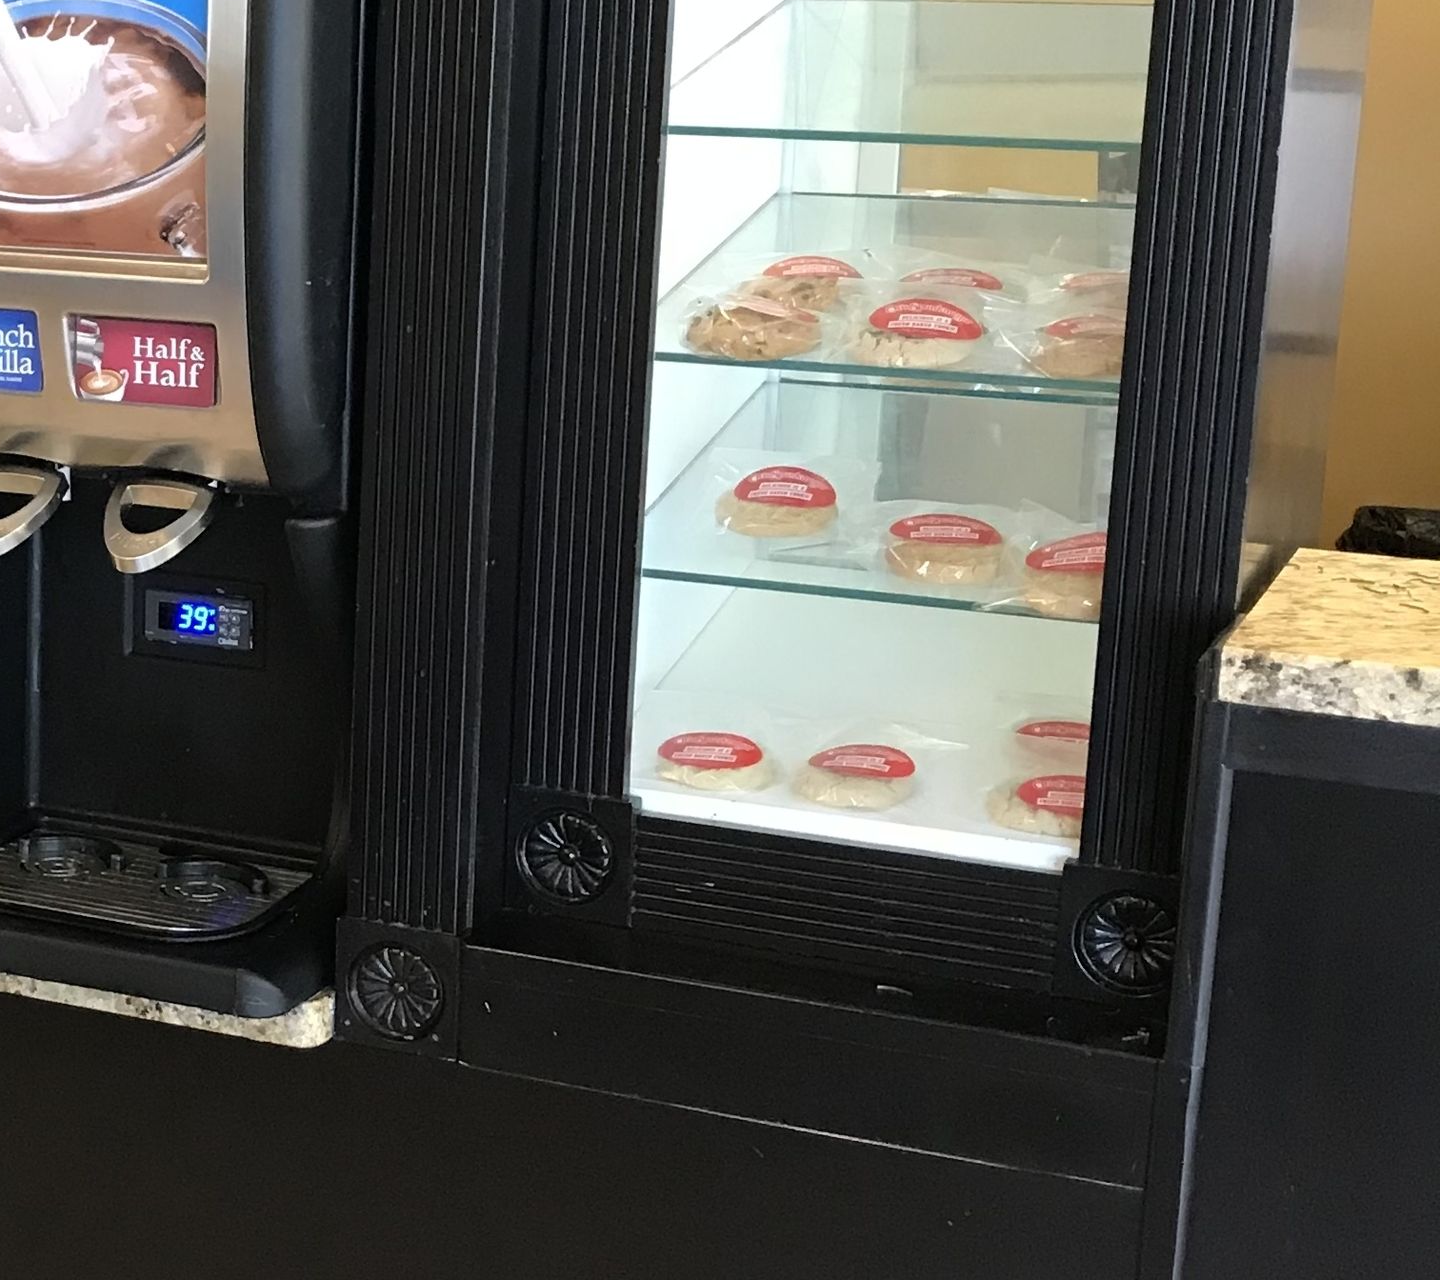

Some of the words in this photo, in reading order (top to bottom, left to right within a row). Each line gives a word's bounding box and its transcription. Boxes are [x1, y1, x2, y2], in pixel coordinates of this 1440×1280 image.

[132, 335, 193, 361] Half
[190, 344, 206, 362] &
[132, 359, 205, 389] Half
[178, 603, 209, 632] 39
